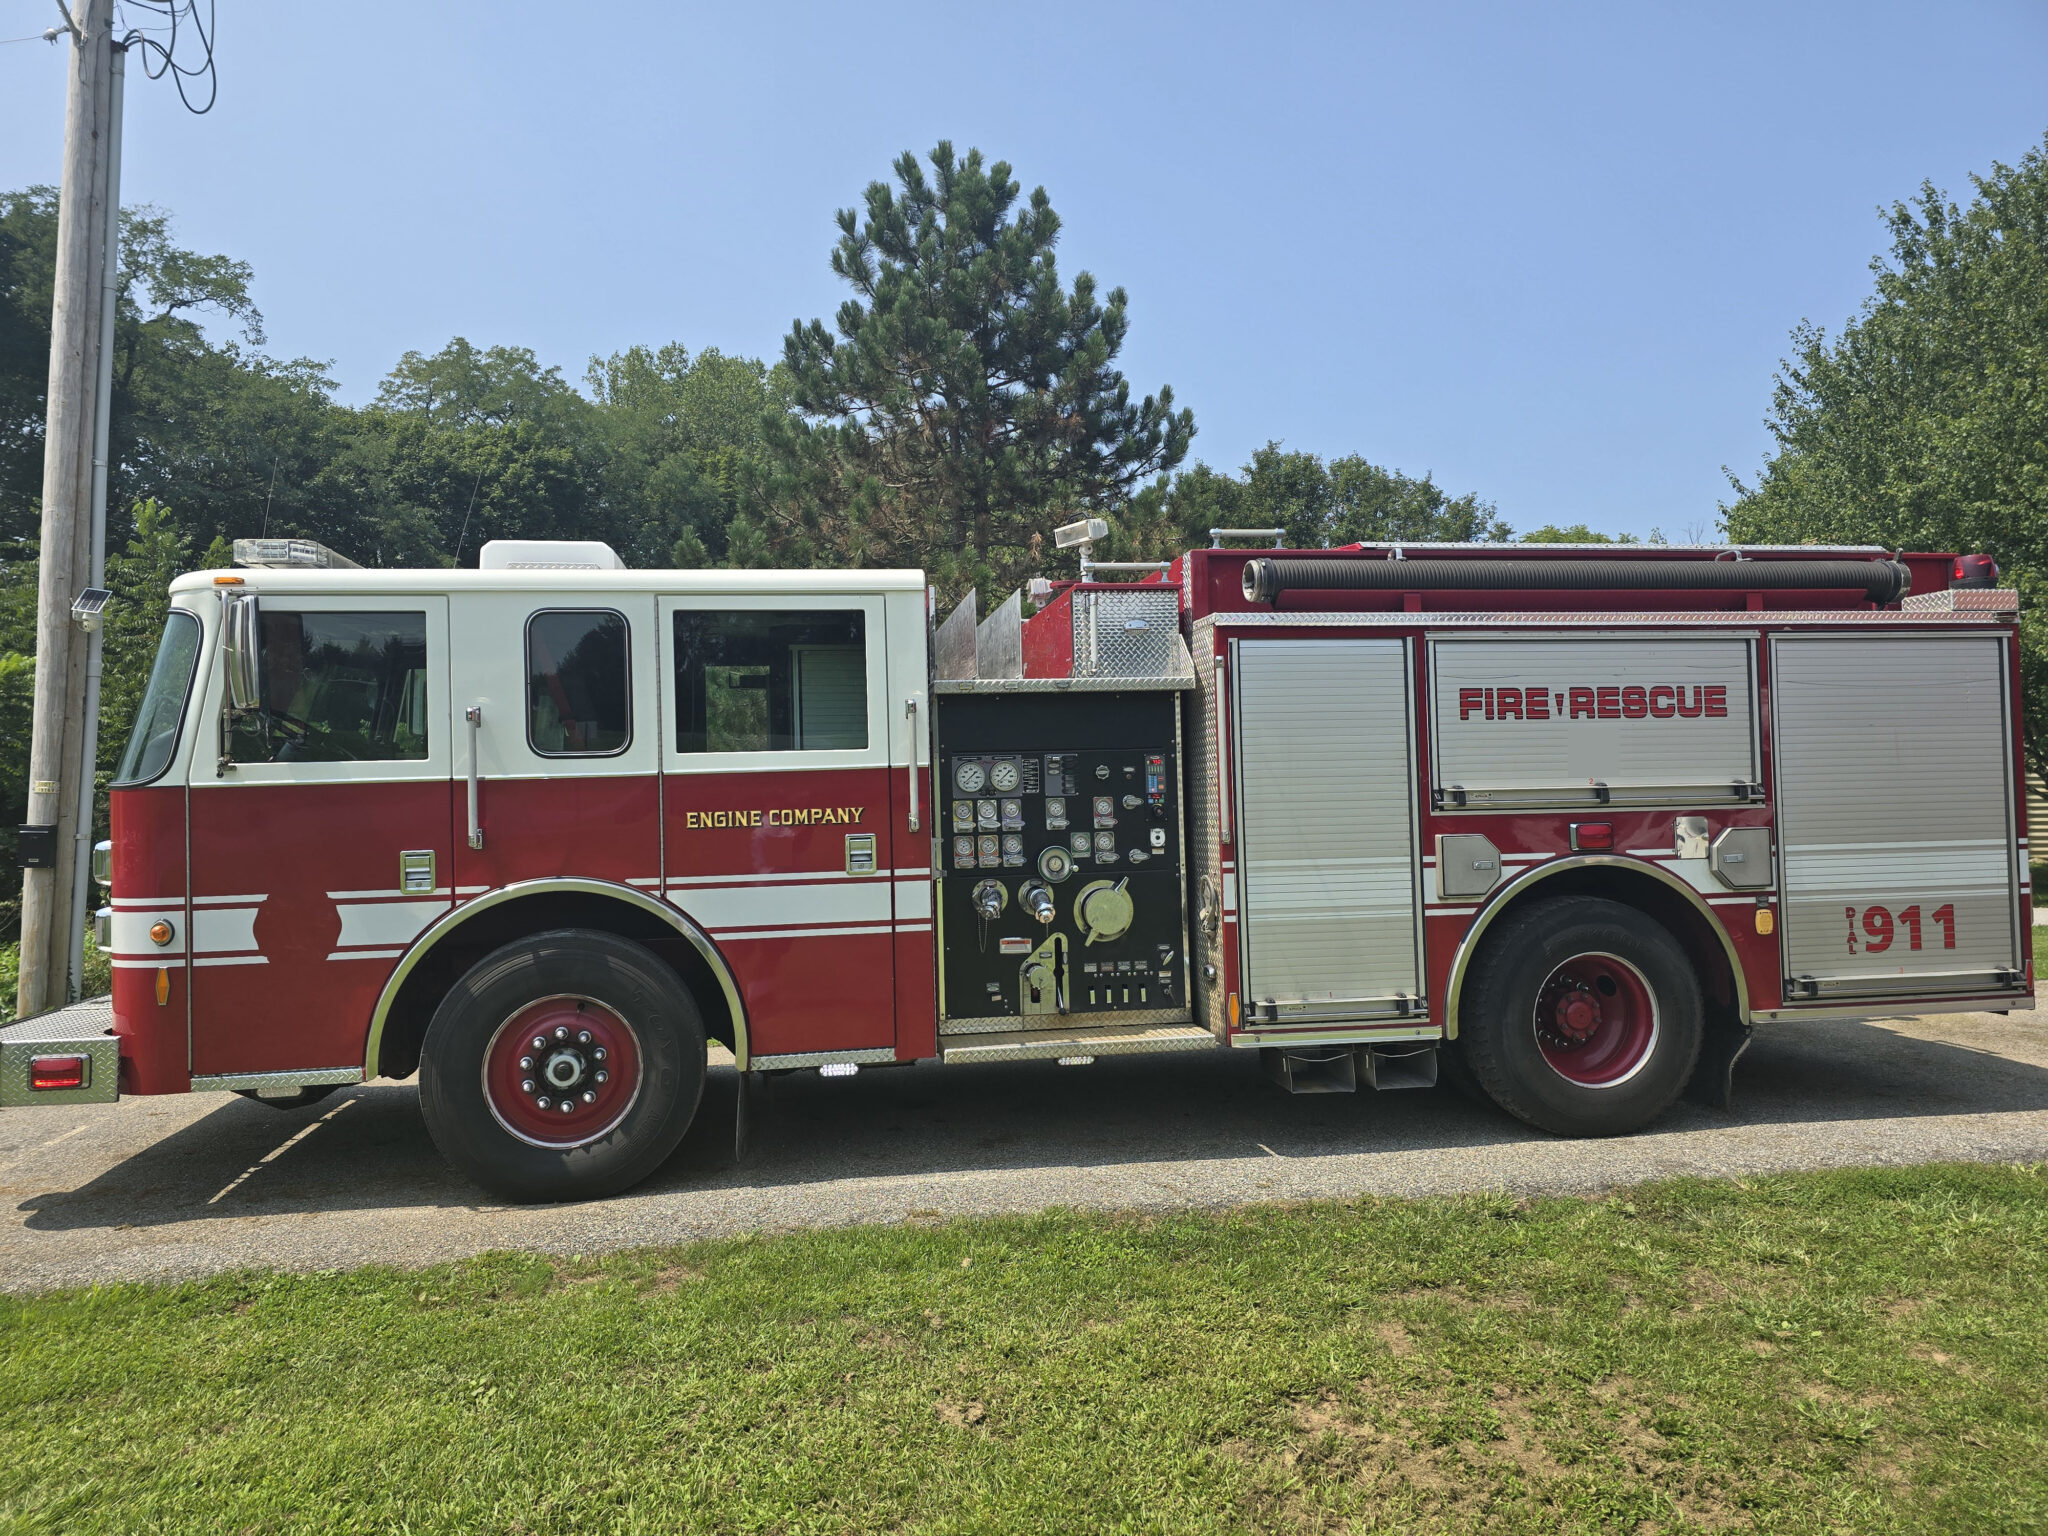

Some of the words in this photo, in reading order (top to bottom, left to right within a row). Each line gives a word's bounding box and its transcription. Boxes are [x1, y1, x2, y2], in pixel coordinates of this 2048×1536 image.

[1459, 687, 1550, 720] FIRE
[1568, 685, 1728, 719] RESCUE
[686, 810, 763, 829] ENGINE
[768, 807, 864, 827] COMPANY
[1845, 906, 1858, 954] DIAL
[1862, 904, 1956, 953] 911
